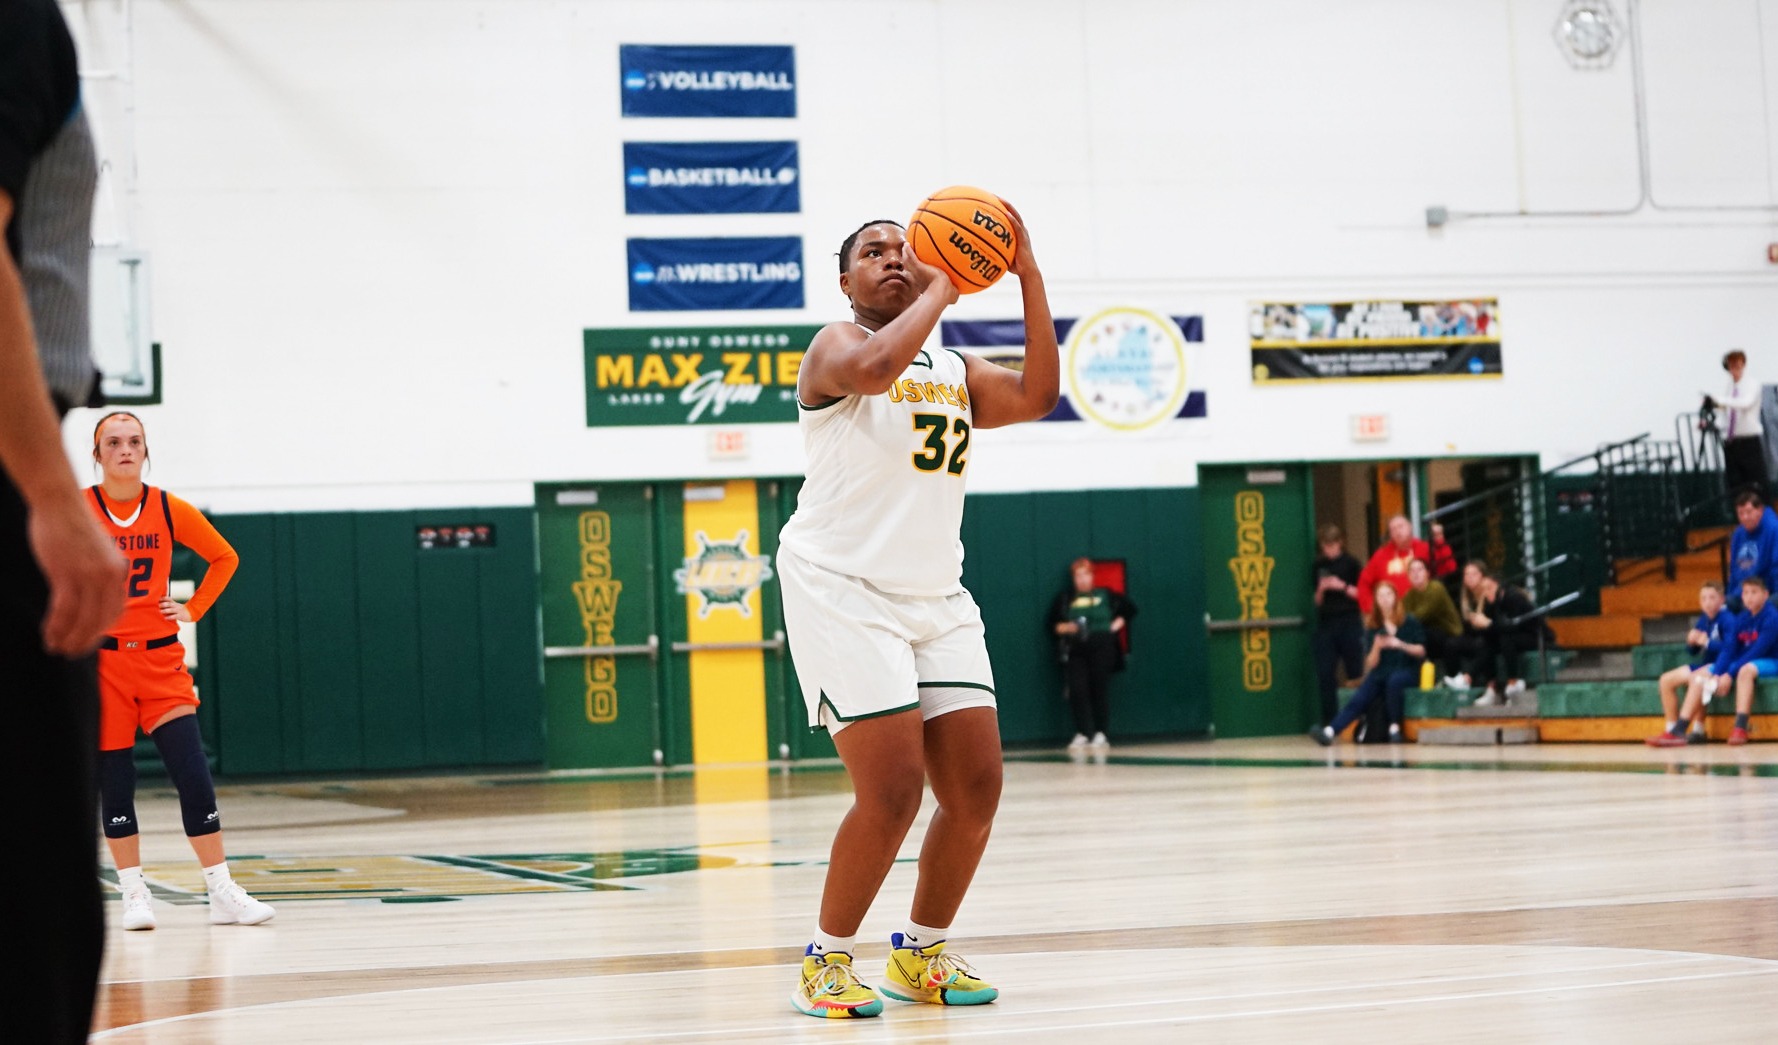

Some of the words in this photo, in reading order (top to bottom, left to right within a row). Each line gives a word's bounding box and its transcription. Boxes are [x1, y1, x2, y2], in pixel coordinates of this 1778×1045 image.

[659, 70, 792, 91] VOLLEYBALL
[648, 167, 777, 186] BASKETBALL
[973, 210, 1013, 249] NCAA
[676, 261, 801, 283] WRESTLING
[948, 230, 1002, 282] Wilson
[596, 352, 703, 388] MAX
[679, 370, 763, 423] Gym
[911, 411, 971, 477] 32
[1229, 490, 1275, 692] OSWEGO
[571, 510, 622, 724] OSWEGO
